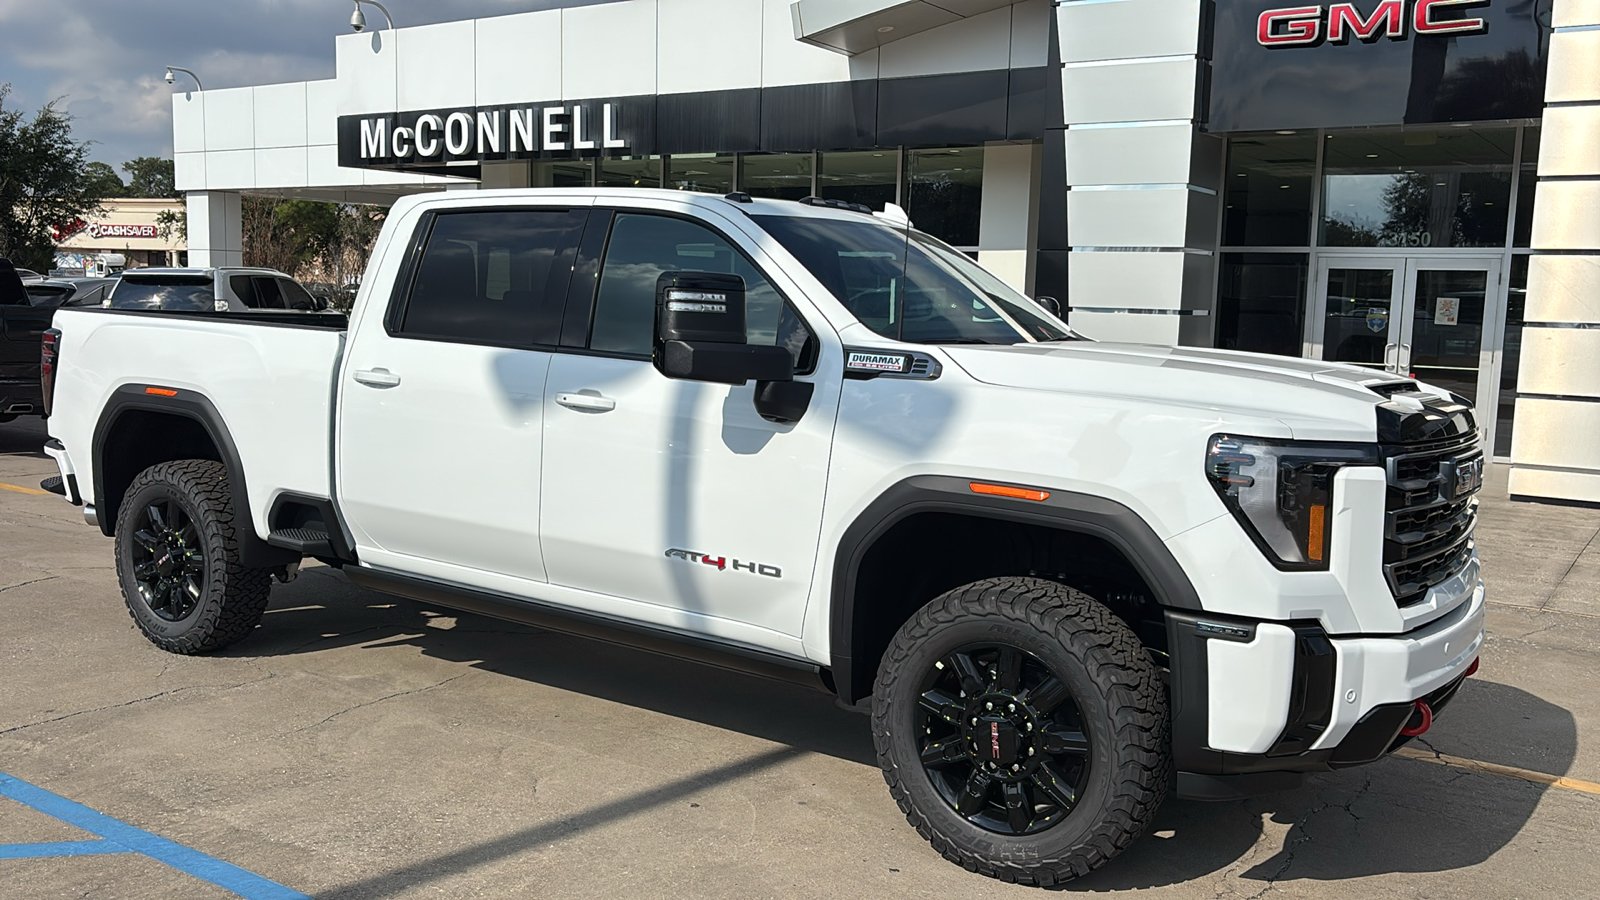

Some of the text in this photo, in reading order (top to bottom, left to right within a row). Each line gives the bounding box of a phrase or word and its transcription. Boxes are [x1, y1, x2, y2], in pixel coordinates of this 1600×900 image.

[1257, 0, 1486, 46] GMC
[360, 103, 625, 159] McCONNELL
[852, 354, 900, 365] DURAMAX
[665, 548, 782, 578] AT4 HD
[991, 722, 1000, 759] GMC
